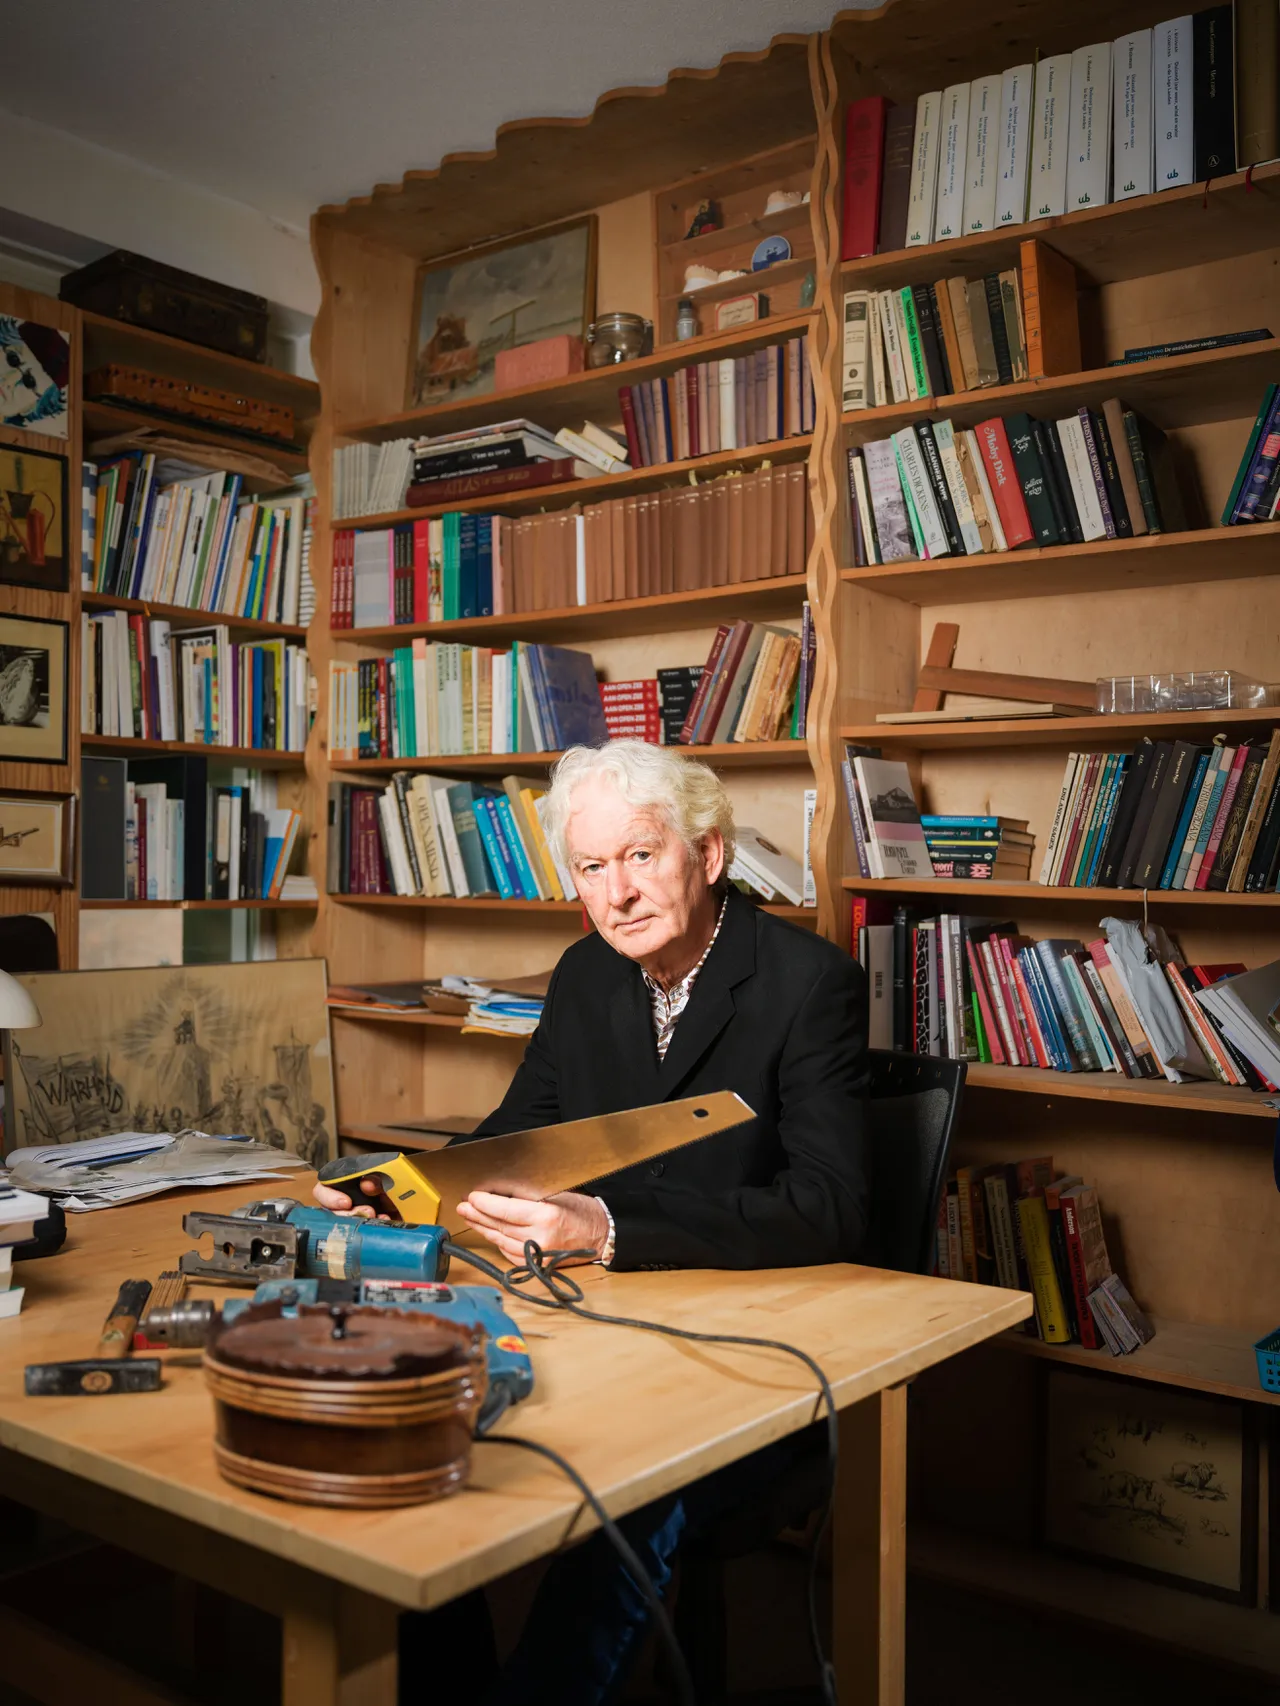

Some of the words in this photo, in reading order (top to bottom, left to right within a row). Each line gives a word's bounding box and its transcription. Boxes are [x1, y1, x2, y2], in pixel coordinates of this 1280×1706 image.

[901, 438, 920, 477] CHARLES
[912, 476, 929, 511] DICKENS
[924, 436, 942, 481] ALEXANDER
[936, 480, 948, 501] POPE
[982, 425, 1001, 461] Moby
[992, 460, 1007, 486] Dick
[1082, 419, 1095, 454] TRISTRAM
[1090, 454, 1101, 481] SHANDY
[442, 476, 481, 496] ATLAS
[636, 714, 646, 722] ZEE
[1048, 826, 1057, 850] SAGEN
[1186, 780, 1213, 842] STRINDBERGIANA
[1198, 782, 1224, 843] STRINDBERGIANA
[1211, 779, 1237, 841] STRINDBERGIANA
[424, 840, 439, 880] MIND
[1064, 1206, 1076, 1235] Anderson
